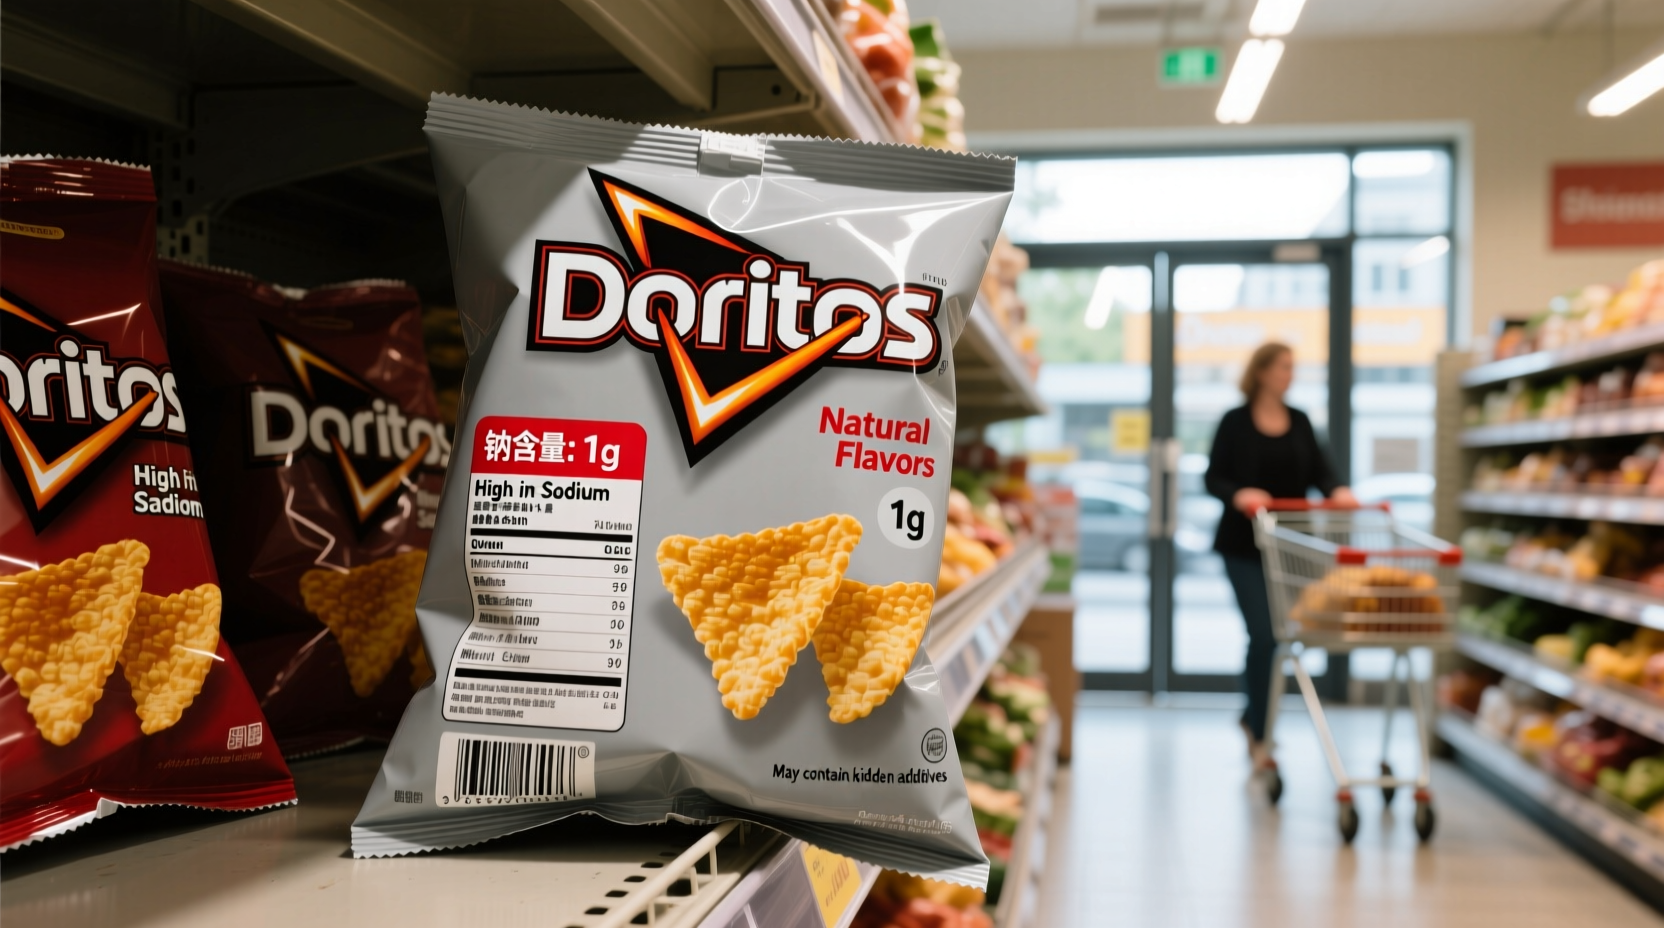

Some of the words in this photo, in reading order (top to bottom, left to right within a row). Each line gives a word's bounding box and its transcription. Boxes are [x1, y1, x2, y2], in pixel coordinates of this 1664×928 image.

[537, 250, 936, 364] Doritos
[819, 406, 930, 445] Natural
[584, 434, 621, 472] 1g
[835, 440, 935, 478] Flavors
[134, 464, 181, 492] High
[474, 479, 514, 502] High
[519, 480, 535, 498] in
[540, 481, 610, 501] Sodium
[890, 499, 925, 541] 1g
[772, 763, 800, 784] May
[802, 767, 850, 783] contain
[852, 767, 894, 784] kidden
